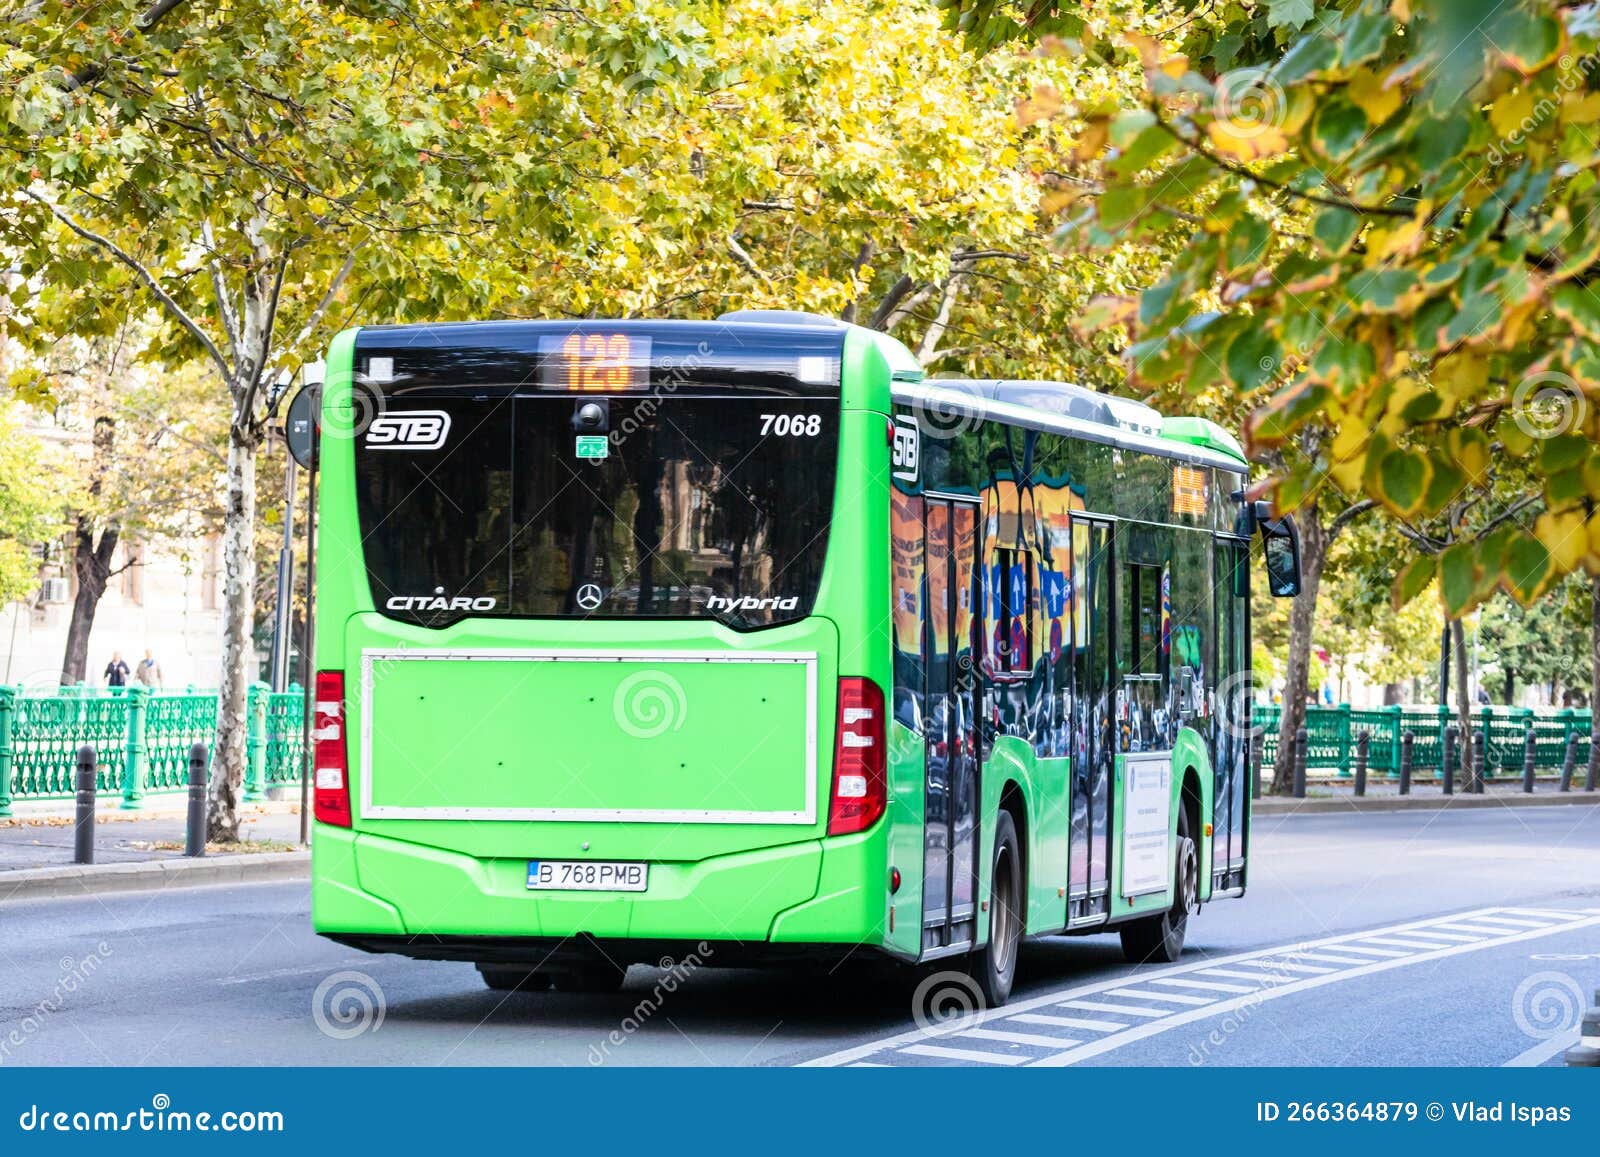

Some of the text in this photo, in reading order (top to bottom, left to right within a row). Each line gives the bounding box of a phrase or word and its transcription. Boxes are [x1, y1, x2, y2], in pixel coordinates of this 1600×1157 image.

[563, 334, 630, 391] 123
[366, 418, 443, 442] STB
[760, 414, 821, 437] 7068
[706, 595, 799, 613] hybrid
[540, 864, 642, 885] B 768 PMB
